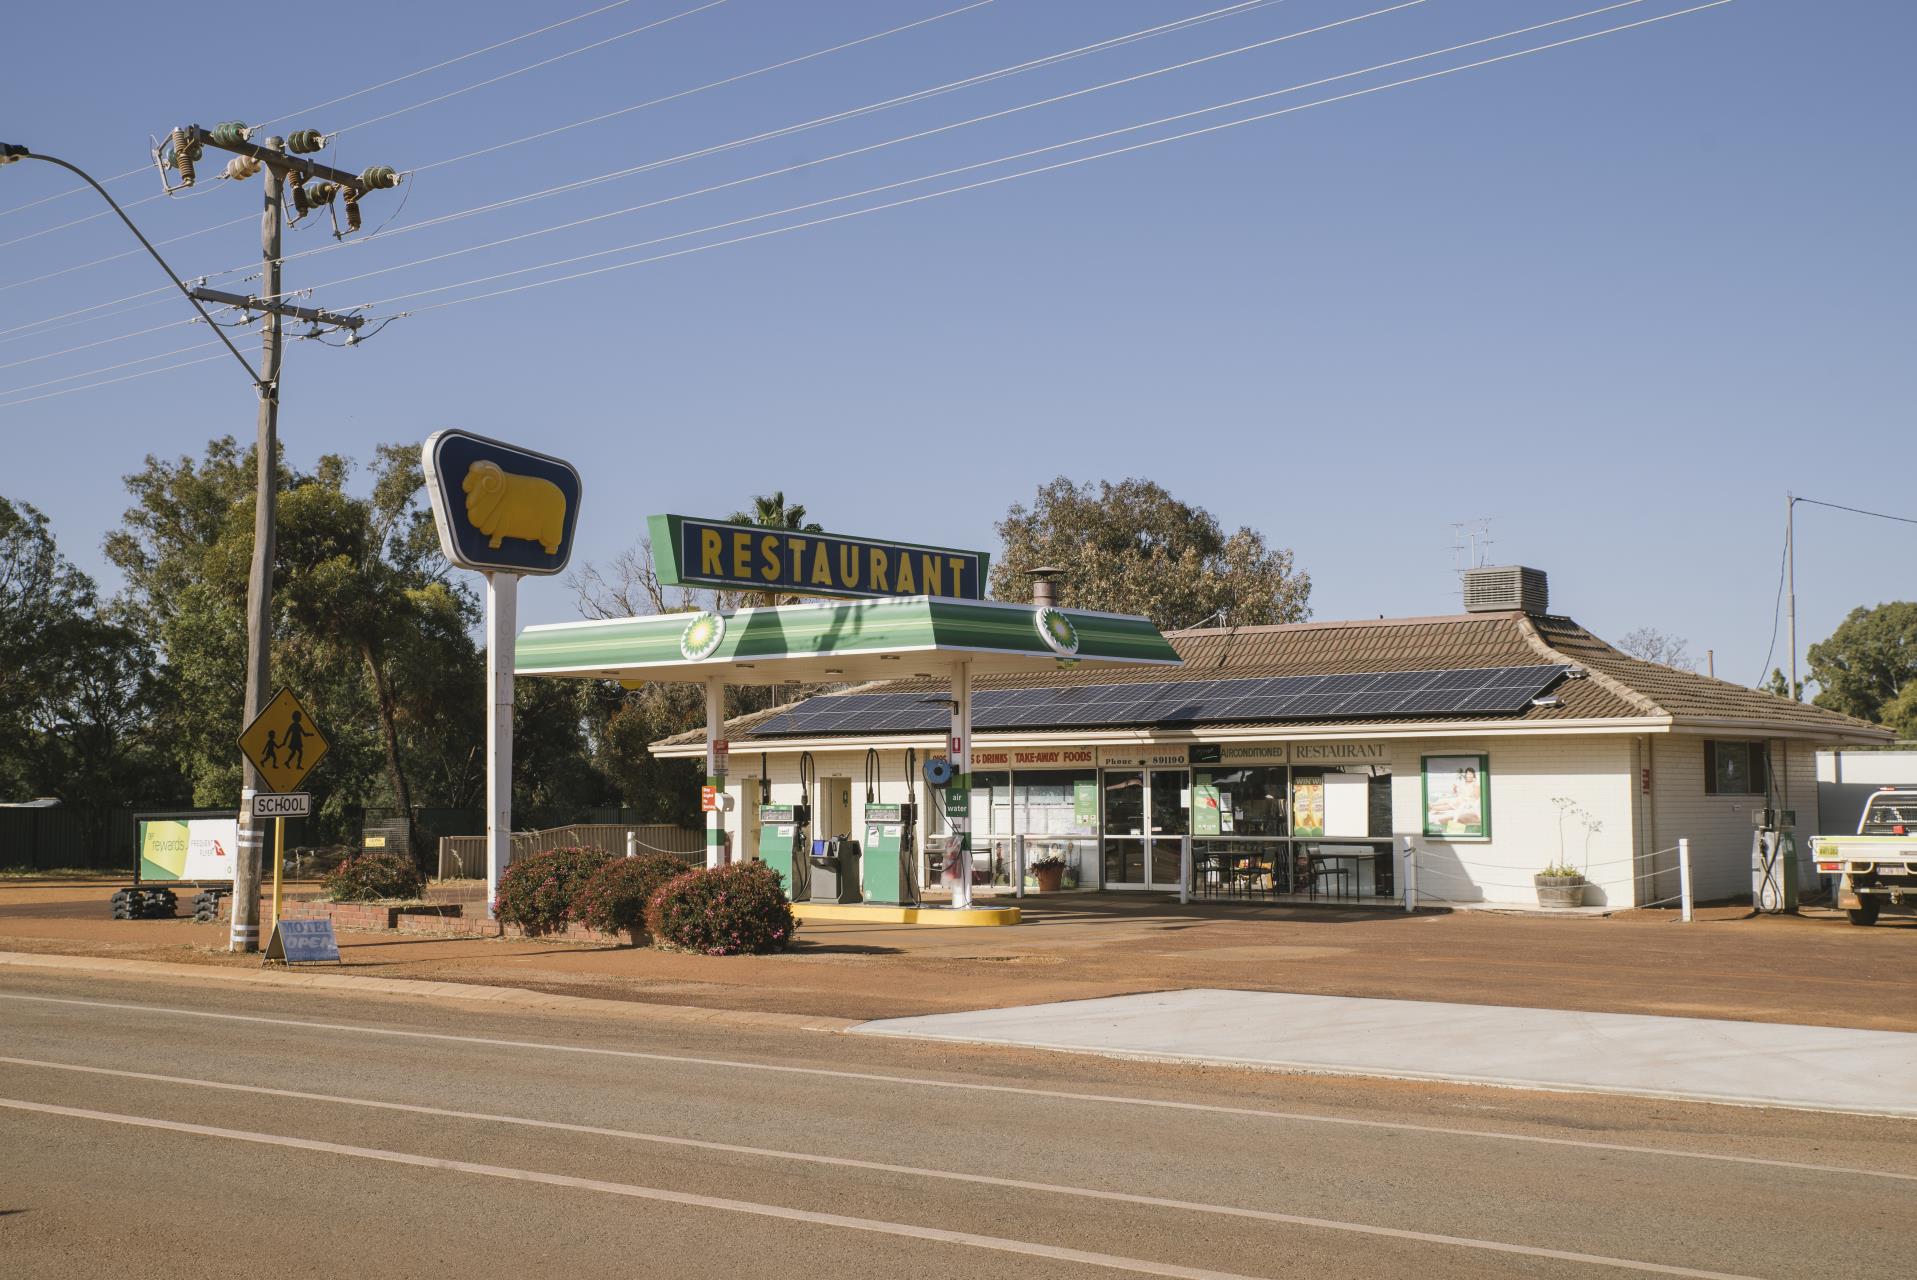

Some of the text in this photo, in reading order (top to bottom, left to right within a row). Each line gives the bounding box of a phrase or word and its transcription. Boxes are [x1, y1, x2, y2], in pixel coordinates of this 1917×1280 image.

[700, 528, 965, 598] RESTAURANT
[1220, 747, 1283, 758] AIRCONDITIONED
[1296, 744, 1385, 758] RESTAURANT
[983, 753, 1008, 764] DRINKS
[1014, 751, 1092, 763] TAKE-AWAY FOODS
[1105, 755, 1185, 765] Phone 891190
[258, 798, 306, 812] SCHOOL
[947, 804, 968, 812] water
